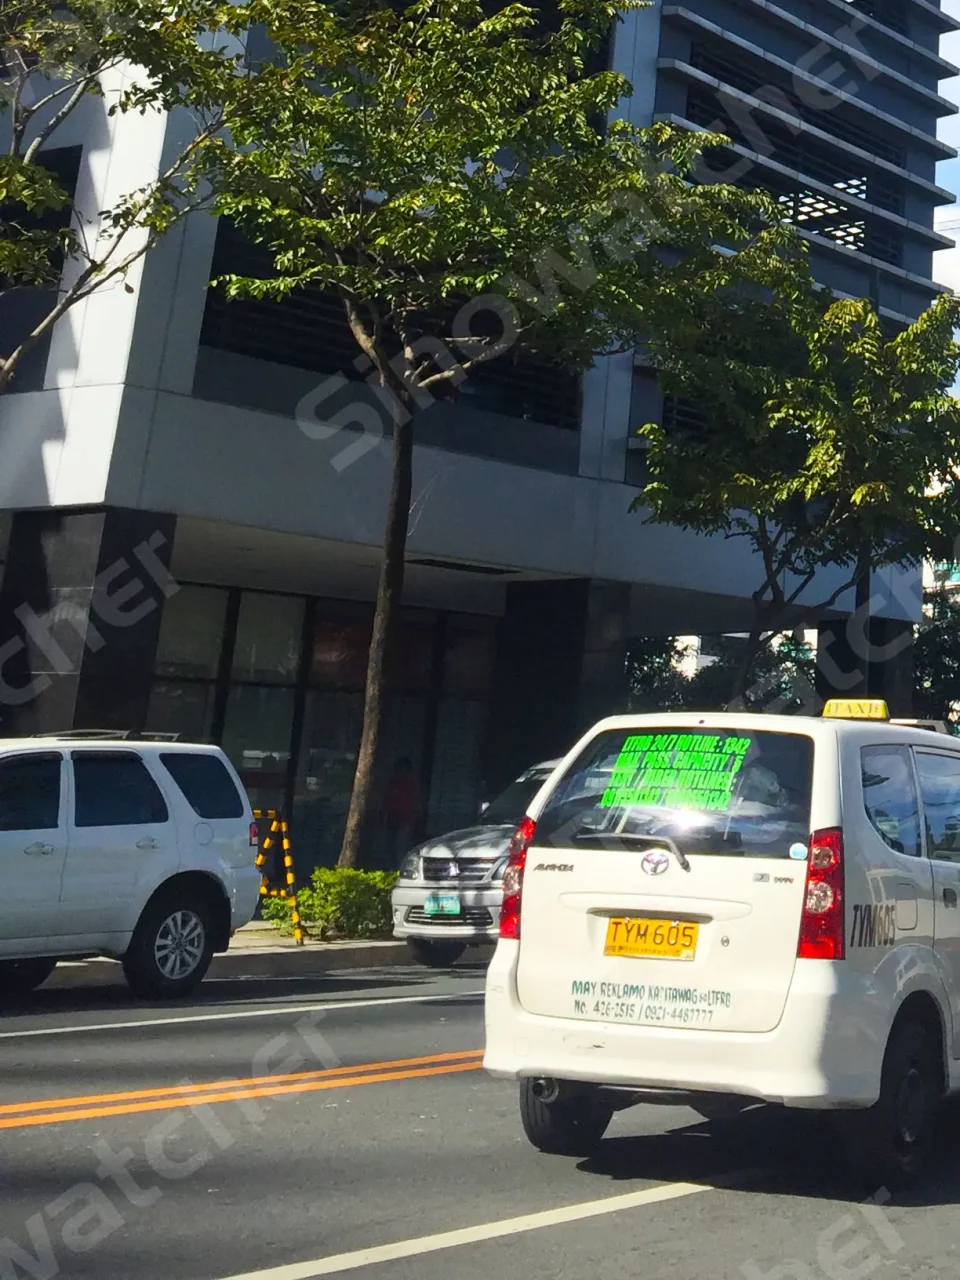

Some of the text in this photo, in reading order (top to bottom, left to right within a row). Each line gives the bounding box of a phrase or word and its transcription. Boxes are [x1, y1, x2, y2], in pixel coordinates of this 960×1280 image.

[722, 737, 751, 755] 1342
[571, 980, 598, 997] MAY
[599, 982, 646, 1000] REKLAMO
